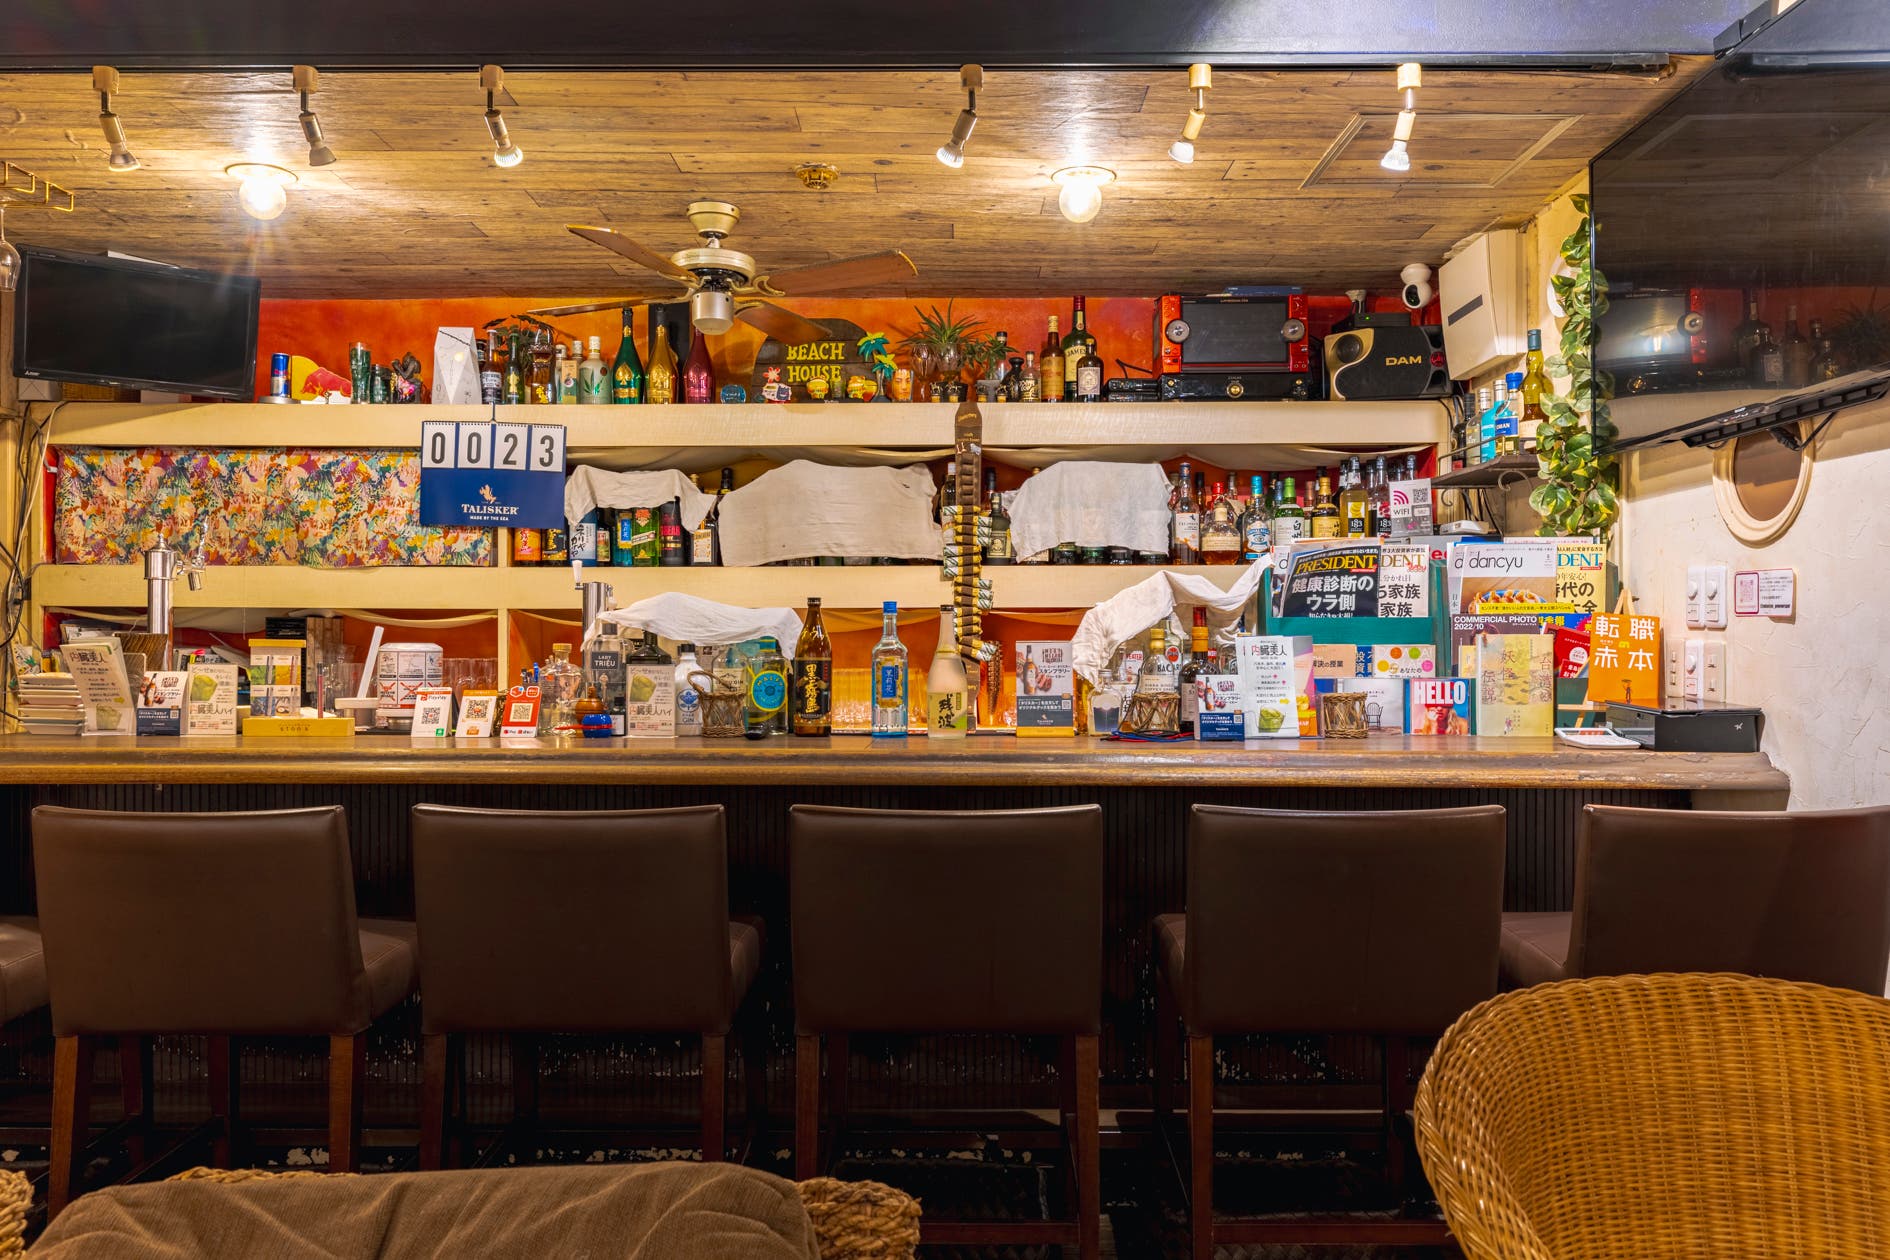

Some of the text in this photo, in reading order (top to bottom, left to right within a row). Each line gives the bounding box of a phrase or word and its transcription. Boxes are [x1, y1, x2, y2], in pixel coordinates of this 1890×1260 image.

[786, 342, 845, 361] BEACH
[1385, 355, 1422, 366] DAM
[786, 365, 842, 383] HOUSE
[461, 503, 518, 515] TALISKER
[1295, 555, 1378, 574] PRESIDENT
[1469, 551, 1524, 573] dancyu
[1292, 575, 1374, 593] 健康診断の
[1306, 593, 1356, 611] ウラ側
[1595, 615, 1655, 640] 転職
[1251, 643, 1288, 657] 内臓美人
[1594, 646, 1654, 671] 赤本
[805, 663, 820, 714] 黒霧島
[1413, 680, 1466, 705] HELLO
